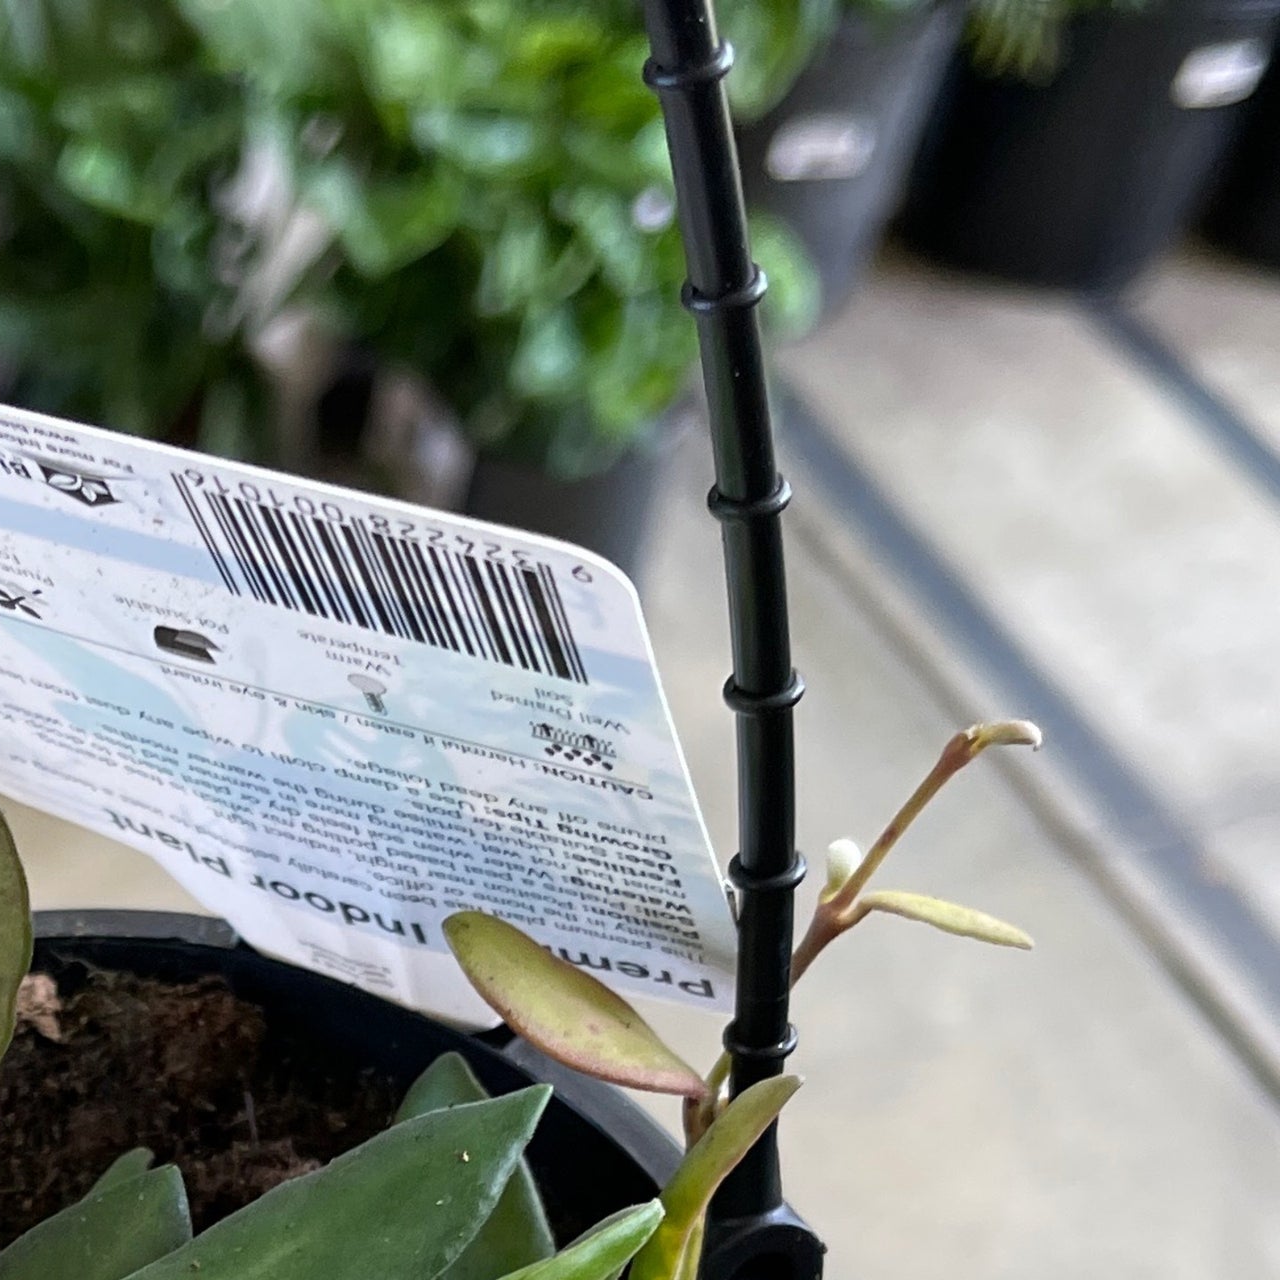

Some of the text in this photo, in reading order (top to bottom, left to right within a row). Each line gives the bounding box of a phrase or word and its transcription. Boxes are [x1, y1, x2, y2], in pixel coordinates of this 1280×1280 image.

[184, 468, 344, 525] 001016
[368, 513, 535, 572] 324228
[532, 762, 654, 800] CAUTION:
[557, 823, 672, 861] Growing
[104, 809, 715, 999] Prem Indoor Plant
[562, 876, 691, 915] Watering:
